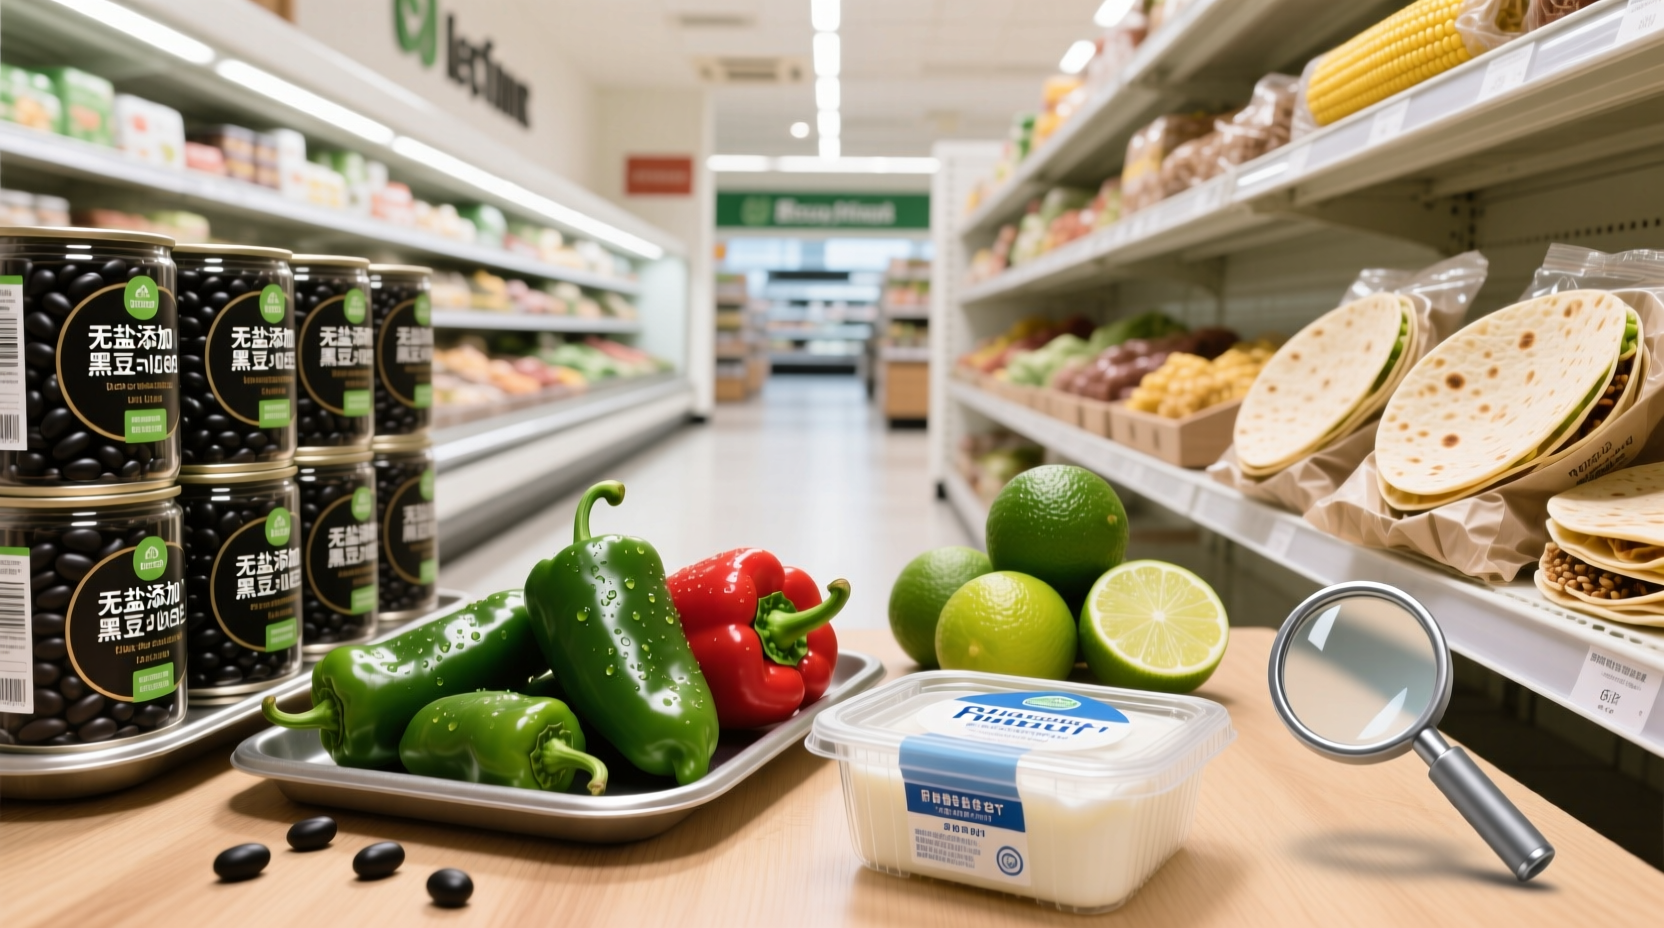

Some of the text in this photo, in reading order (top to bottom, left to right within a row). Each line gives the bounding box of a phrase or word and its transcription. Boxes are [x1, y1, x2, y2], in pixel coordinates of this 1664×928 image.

[88, 323, 173, 350] 无盐添加
[319, 325, 374, 347] 无盐
[98, 581, 180, 616] 无盐添加
